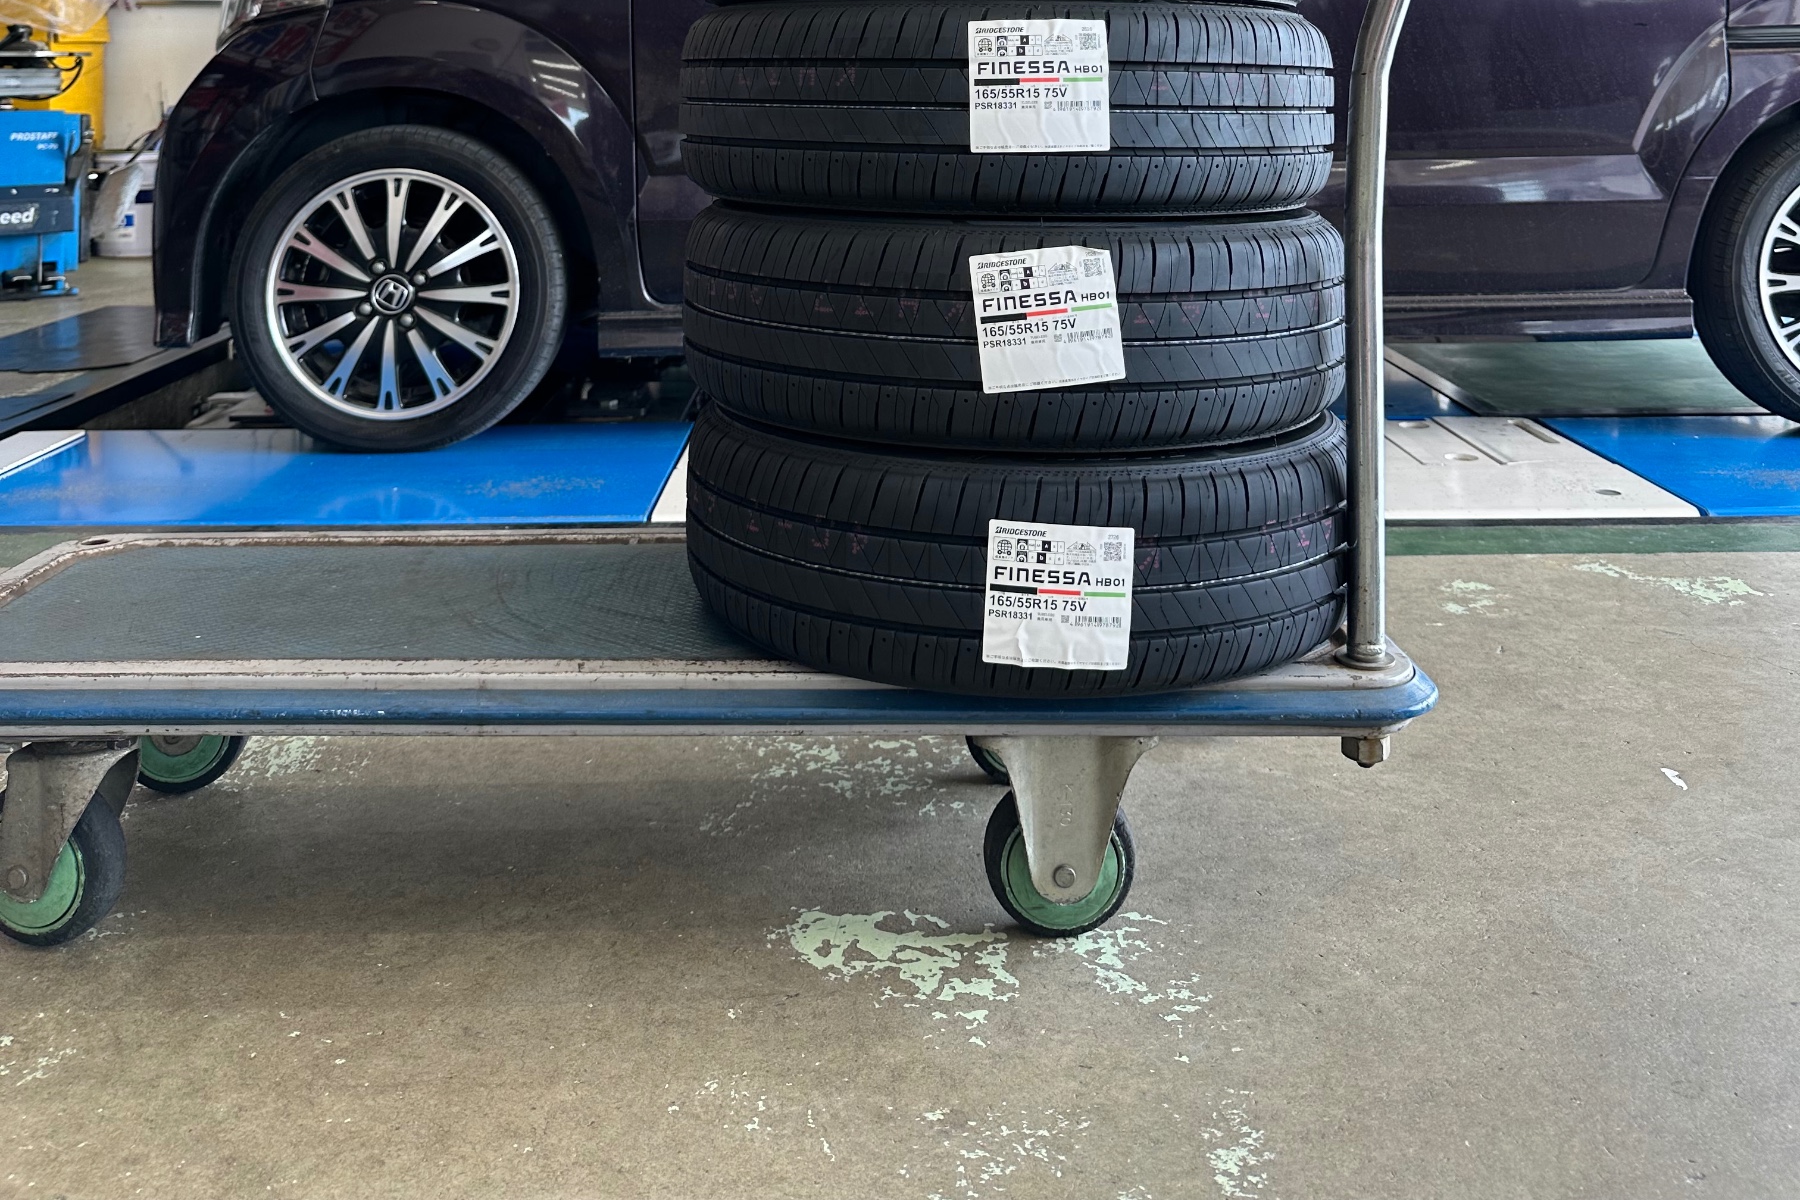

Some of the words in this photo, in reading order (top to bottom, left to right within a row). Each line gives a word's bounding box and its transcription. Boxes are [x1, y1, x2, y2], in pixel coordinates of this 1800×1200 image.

[975, 26, 1024, 34] BRIDGESTONE
[977, 60, 1070, 75] FINESSA
[1074, 65, 1103, 73] HB01
[974, 88, 1040, 99] 165/55R15
[1044, 87, 1068, 98] 75V
[974, 102, 1017, 110] PSR18331
[977, 257, 1027, 269] BRIDGESTONE
[982, 289, 1077, 313] FINESSA
[1081, 291, 1110, 303] HB01
[982, 321, 1049, 338] 165/55R15
[1052, 318, 1077, 331] 75V
[983, 337, 1027, 349] PSR18331
[995, 526, 1047, 537] BRIDGESTONE
[994, 565, 1092, 586] FINESSA
[1095, 578, 1125, 587] HB01
[989, 594, 1058, 611] 165/55R15
[1062, 600, 1087, 612] 75V
[988, 609, 1033, 620] PSR18331
